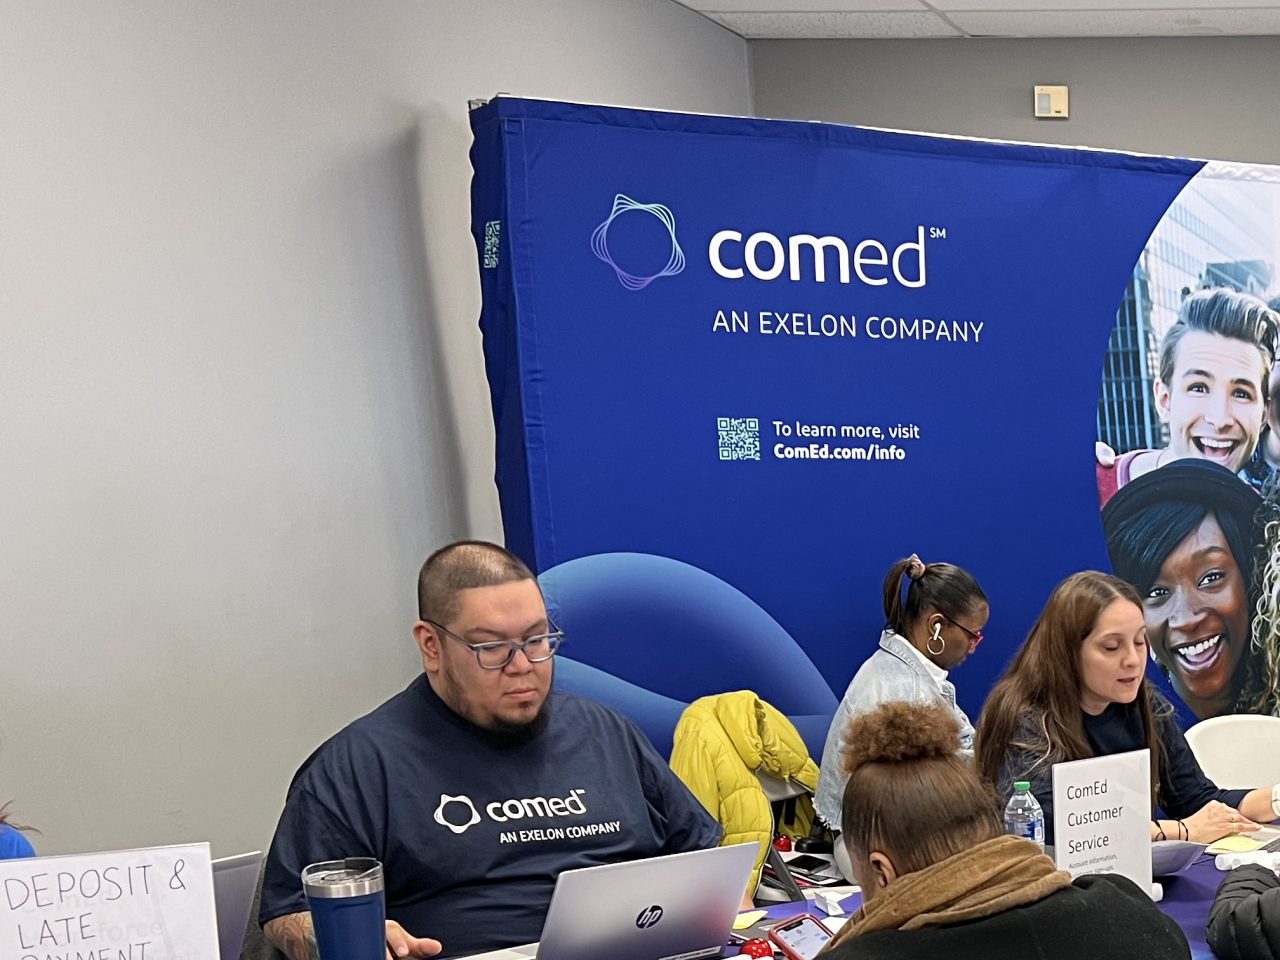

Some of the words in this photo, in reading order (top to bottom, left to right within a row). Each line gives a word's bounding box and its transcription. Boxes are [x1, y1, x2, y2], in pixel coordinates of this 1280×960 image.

[708, 225, 926, 288] comed
[712, 310, 749, 333] AN
[759, 311, 857, 338] EXELON
[865, 316, 985, 343] COMPANY
[772, 421, 792, 437] To
[796, 421, 837, 437] learn
[841, 425, 885, 440] more,
[889, 424, 921, 439] visit
[773, 443, 906, 461] ComEd.com/info
[1067, 779, 1108, 801] ComEd
[486, 789, 587, 823] comed
[1067, 805, 1124, 828] Customer
[499, 830, 518, 844] AN
[519, 828, 565, 843] EXELON
[566, 820, 621, 839] COMPANY
[1068, 834, 1109, 855] Service
[4, 864, 153, 911] DEPOSIT
[168, 858, 187, 891] &
[635, 904, 664, 929] hp
[17, 912, 97, 950] LATE
